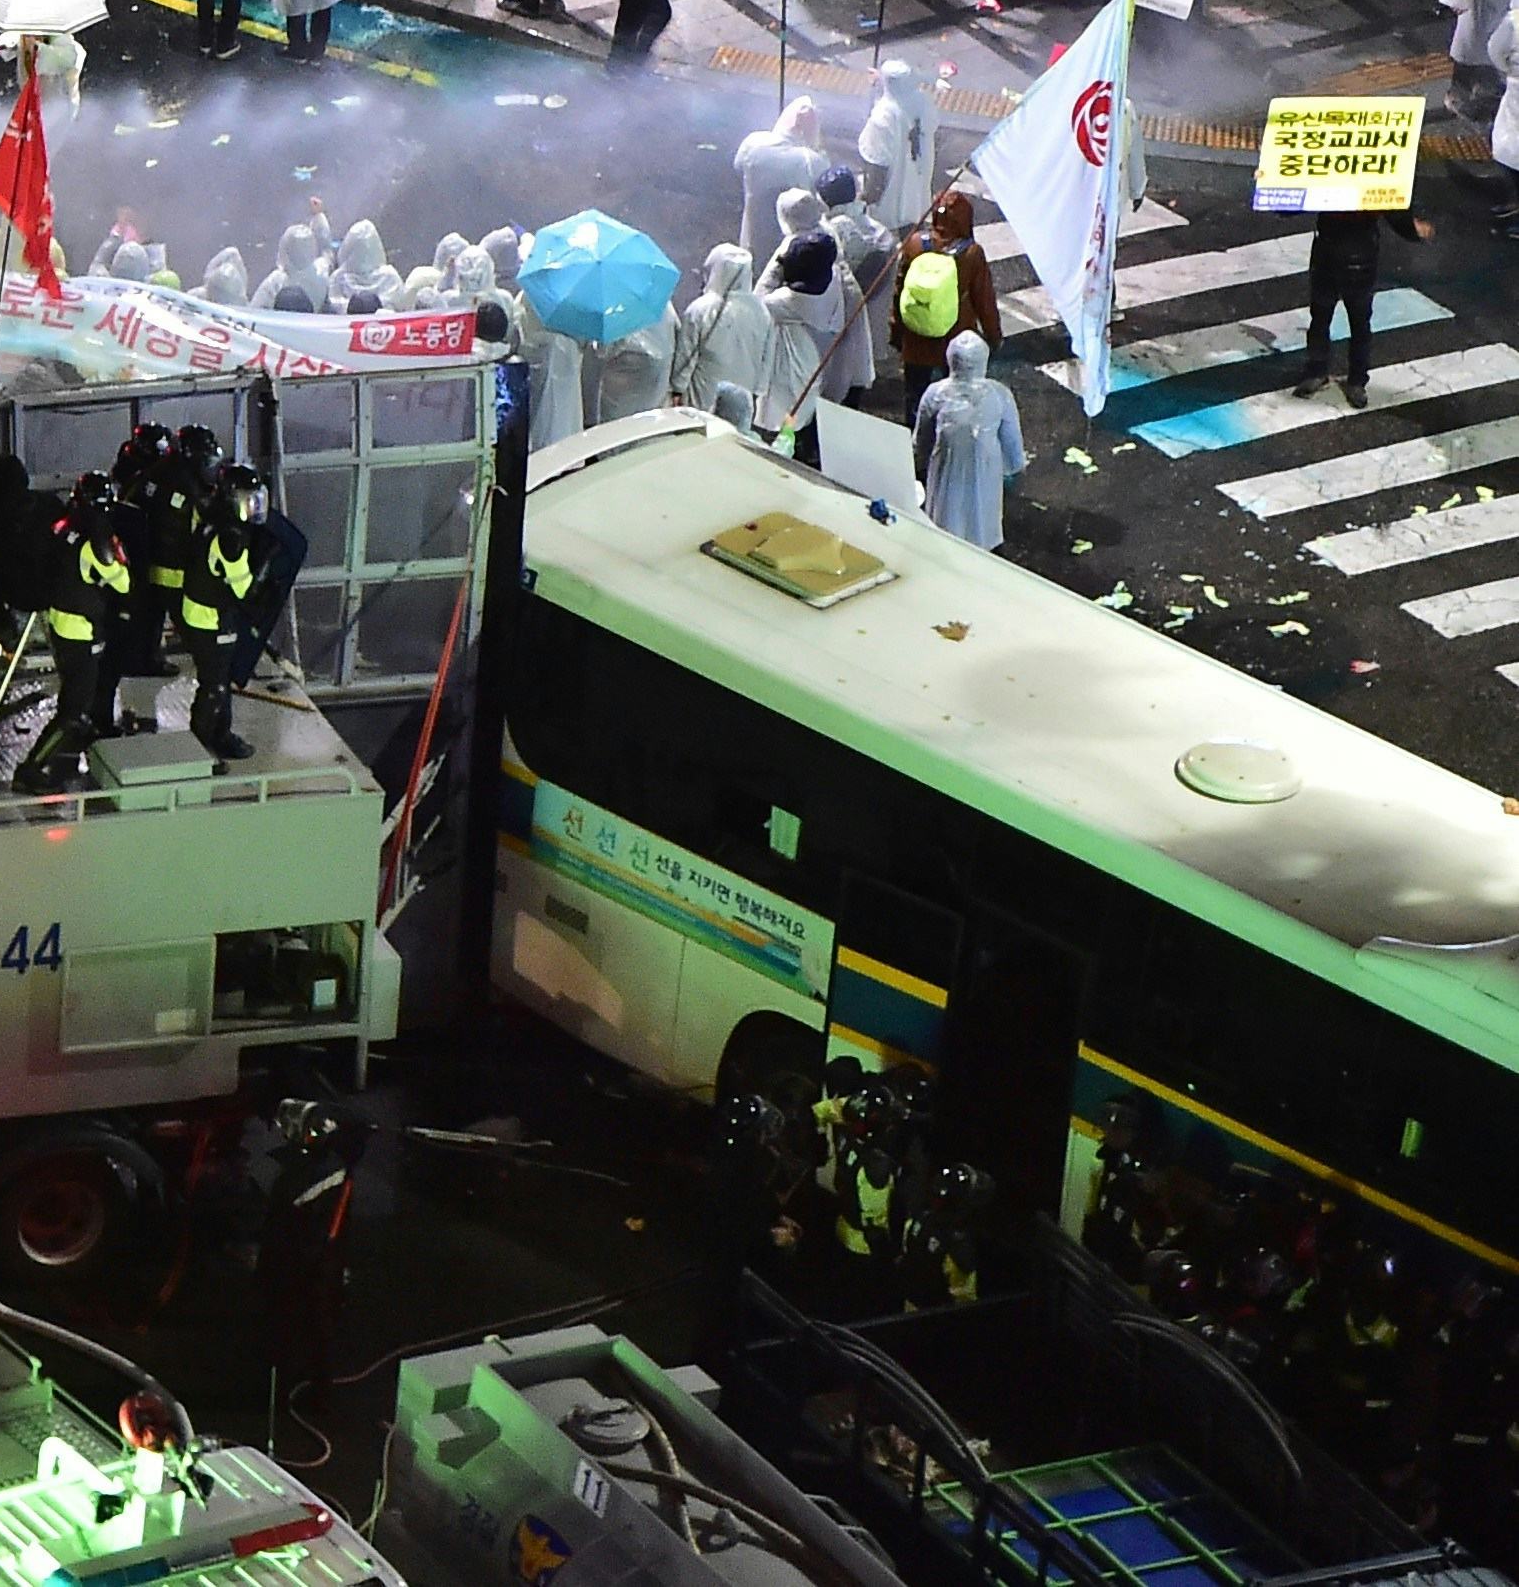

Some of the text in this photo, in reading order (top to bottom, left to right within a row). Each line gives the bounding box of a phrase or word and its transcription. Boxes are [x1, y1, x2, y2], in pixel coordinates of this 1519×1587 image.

[1274, 130, 1409, 150] 국정교과서
[1279, 154, 1398, 177] 중단하라!
[93, 302, 232, 372] 세상을
[400, 316, 464, 348] 노동당
[687, 866, 731, 906] 지키면
[1, 922, 64, 975] 44
